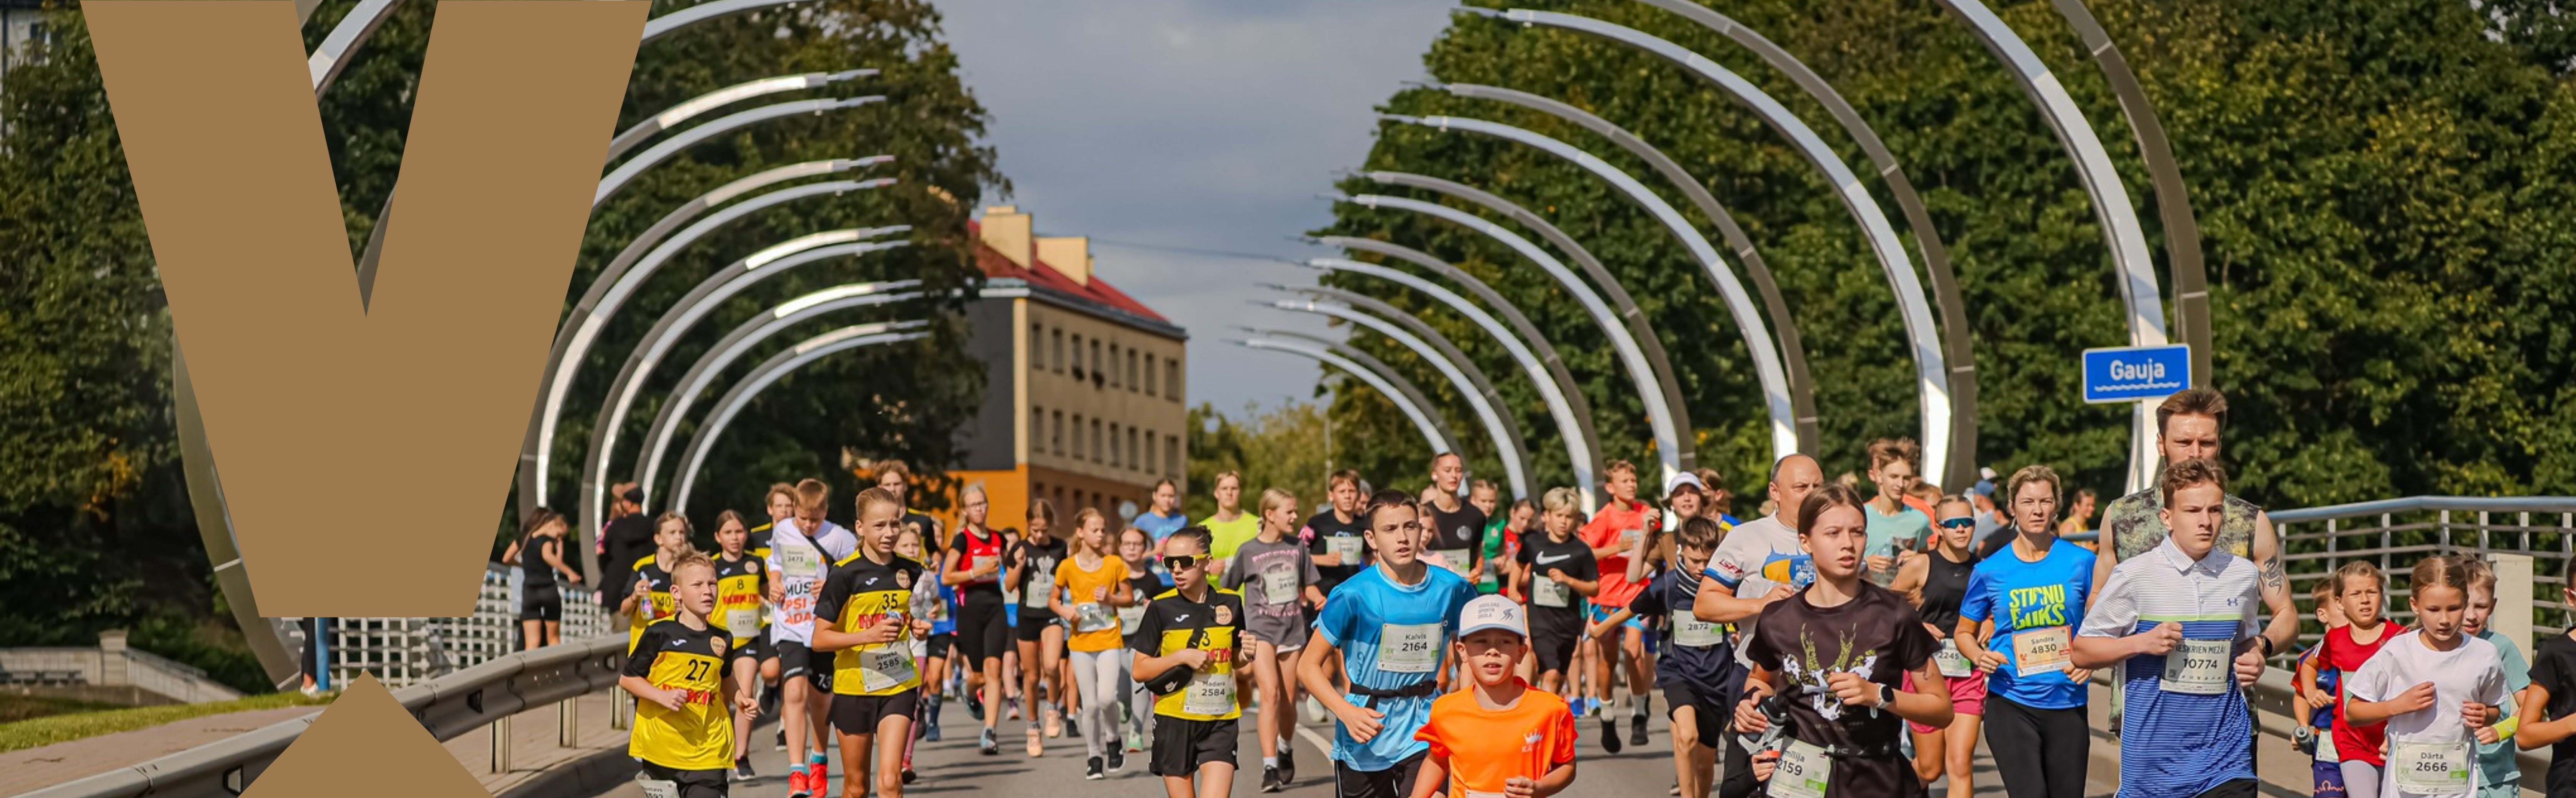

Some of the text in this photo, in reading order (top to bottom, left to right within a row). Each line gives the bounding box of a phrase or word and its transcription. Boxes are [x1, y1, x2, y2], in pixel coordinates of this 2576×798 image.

[2110, 358, 2165, 387] Gauja
[737, 579, 744, 590] 8
[882, 593, 897, 610] 35
[1402, 642, 1427, 652] 2164
[2031, 644, 2057, 654] 4830
[877, 658, 899, 670] 2585
[2183, 659, 2218, 669] 10774
[685, 659, 711, 682] 27
[1777, 758, 1803, 776] 2159
[2416, 761, 2448, 772] 2666
